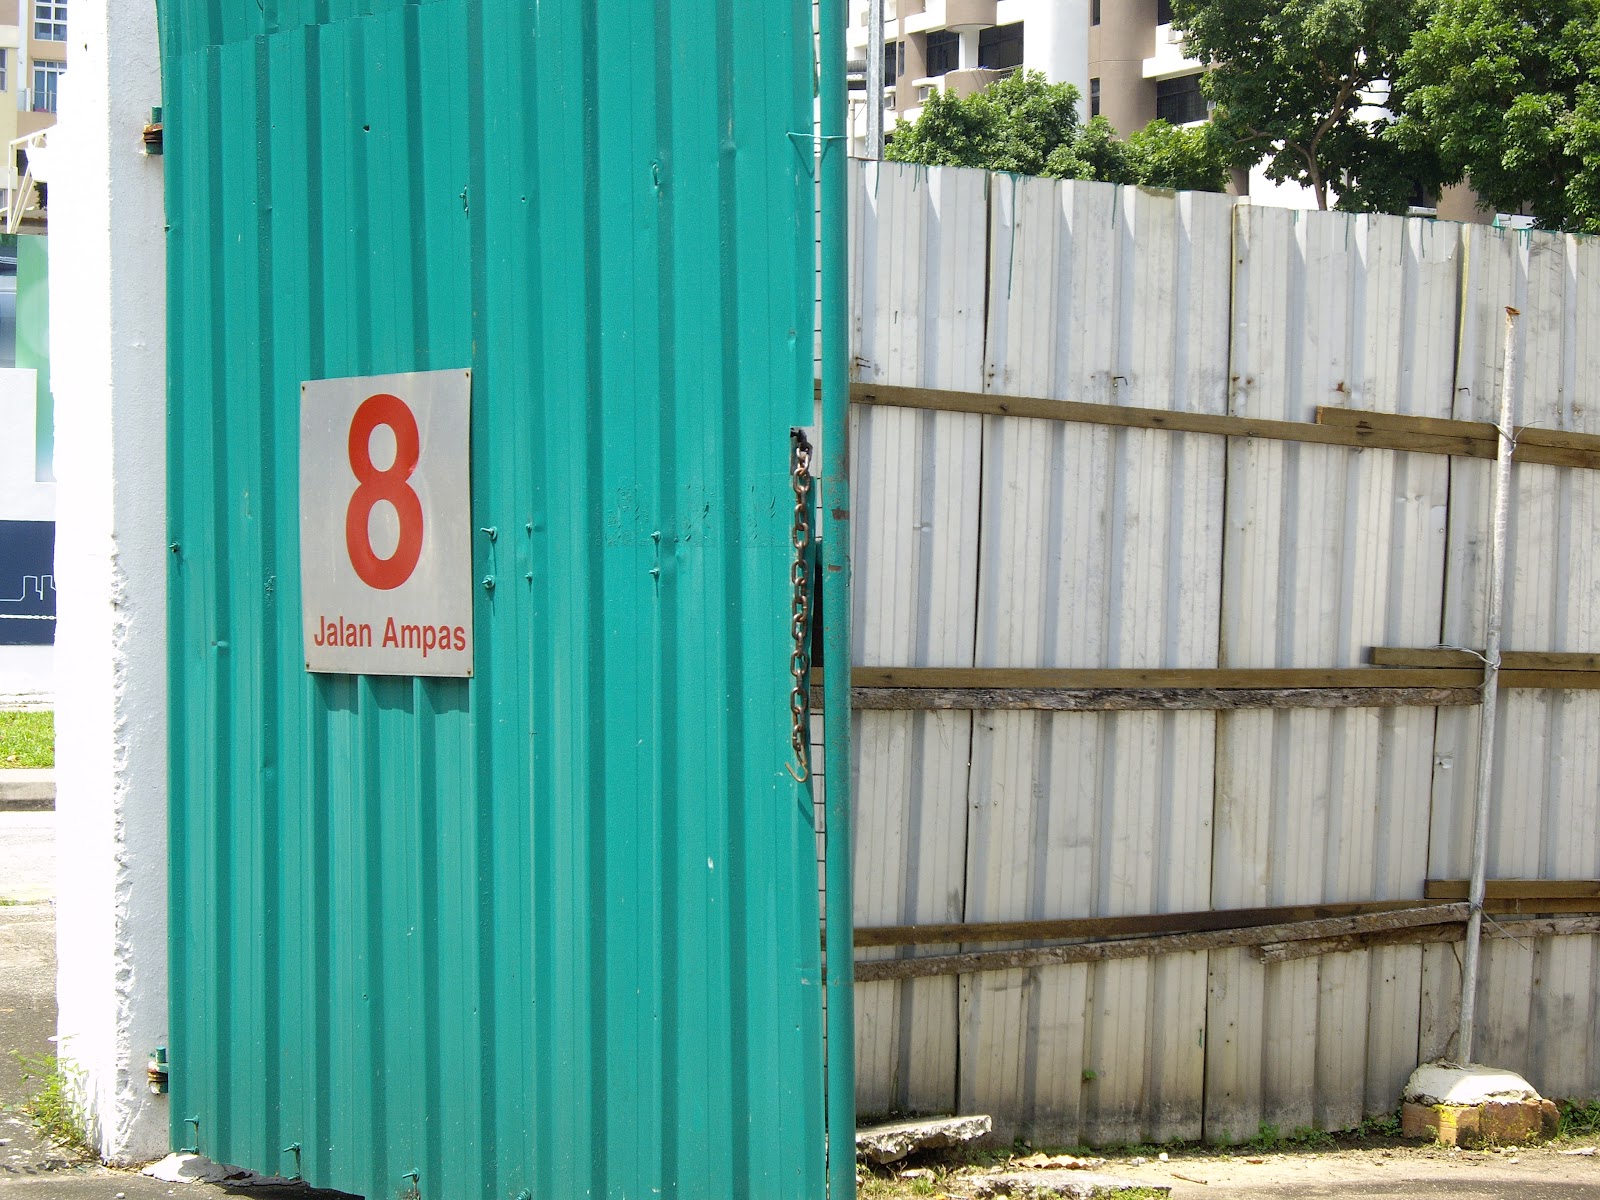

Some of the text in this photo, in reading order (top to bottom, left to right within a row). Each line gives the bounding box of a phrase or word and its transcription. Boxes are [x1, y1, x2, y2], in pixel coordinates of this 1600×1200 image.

[345, 393, 424, 591] 8
[314, 616, 466, 657] Jalan Ampas
